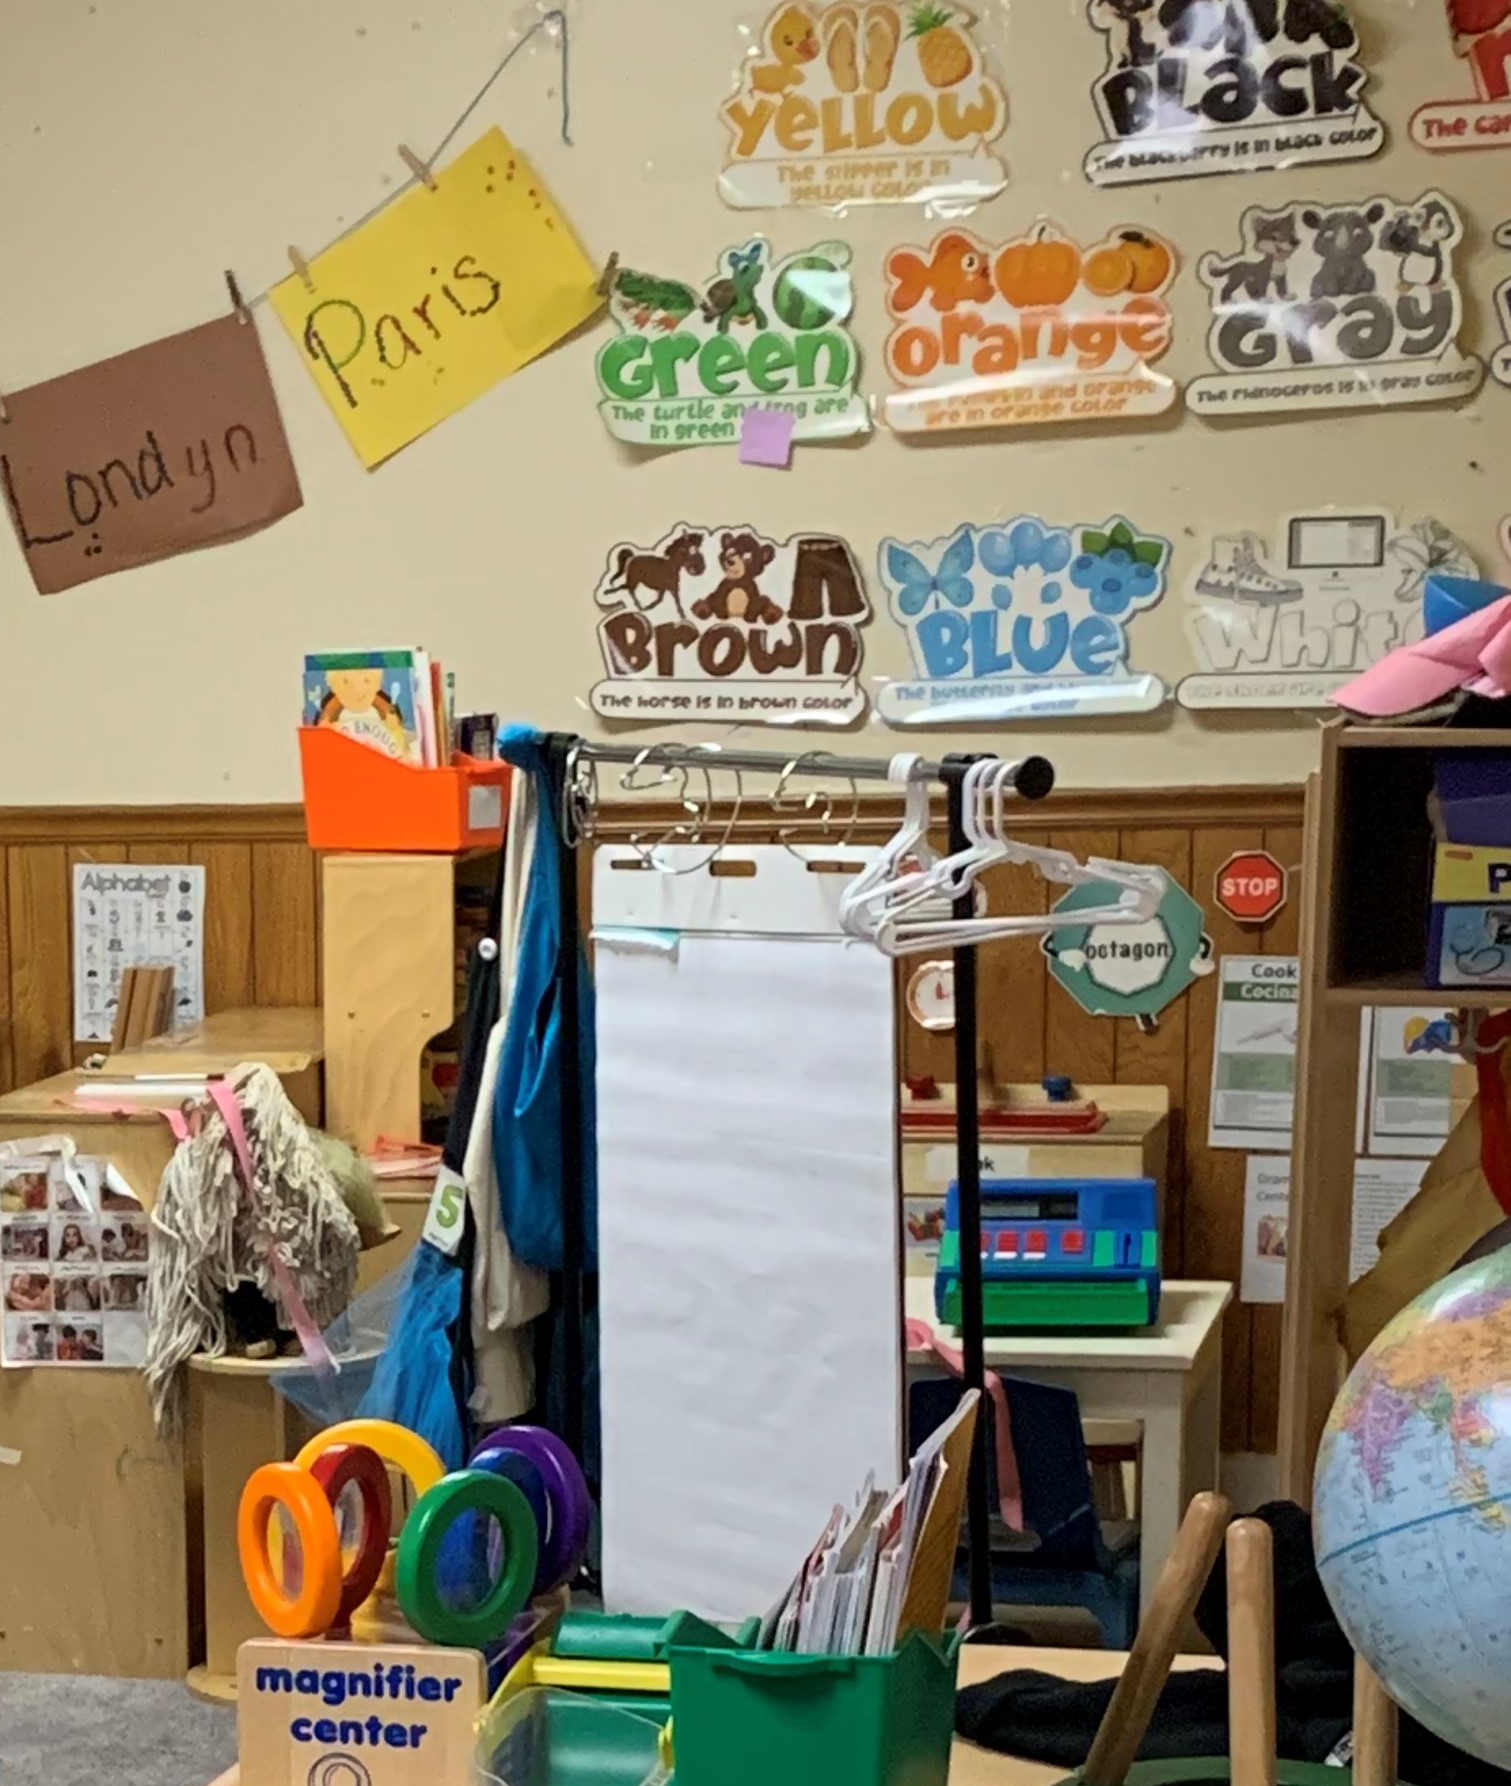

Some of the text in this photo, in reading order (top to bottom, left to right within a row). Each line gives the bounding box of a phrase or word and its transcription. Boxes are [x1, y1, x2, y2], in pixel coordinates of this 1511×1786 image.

[1422, 118, 1467, 139] The
[1234, 141, 1250, 156] is
[1254, 139, 1271, 153] in
[778, 165, 815, 182] The
[905, 159, 924, 177] is
[303, 255, 501, 408] Paris
[892, 297, 1168, 376] orange
[1218, 290, 1453, 368] Gray
[600, 331, 849, 400] Green
[1197, 389, 1228, 403] The
[612, 404, 645, 422] The
[653, 401, 715, 421] turtle
[814, 398, 848, 414] are
[925, 407, 960, 425] are
[965, 406, 985, 421] in
[991, 402, 1065, 420] orange
[650, 421, 735, 440] in green
[0, 422, 257, 549] Londyn
[604, 612, 858, 677] Brown
[600, 694, 853, 710] The horse is in brown color
[896, 686, 926, 701] The
[1221, 877, 1279, 897] STOP
[1086, 940, 1170, 961] octagon
[256, 1662, 463, 1706] magnifier
[290, 1715, 428, 1749] center
